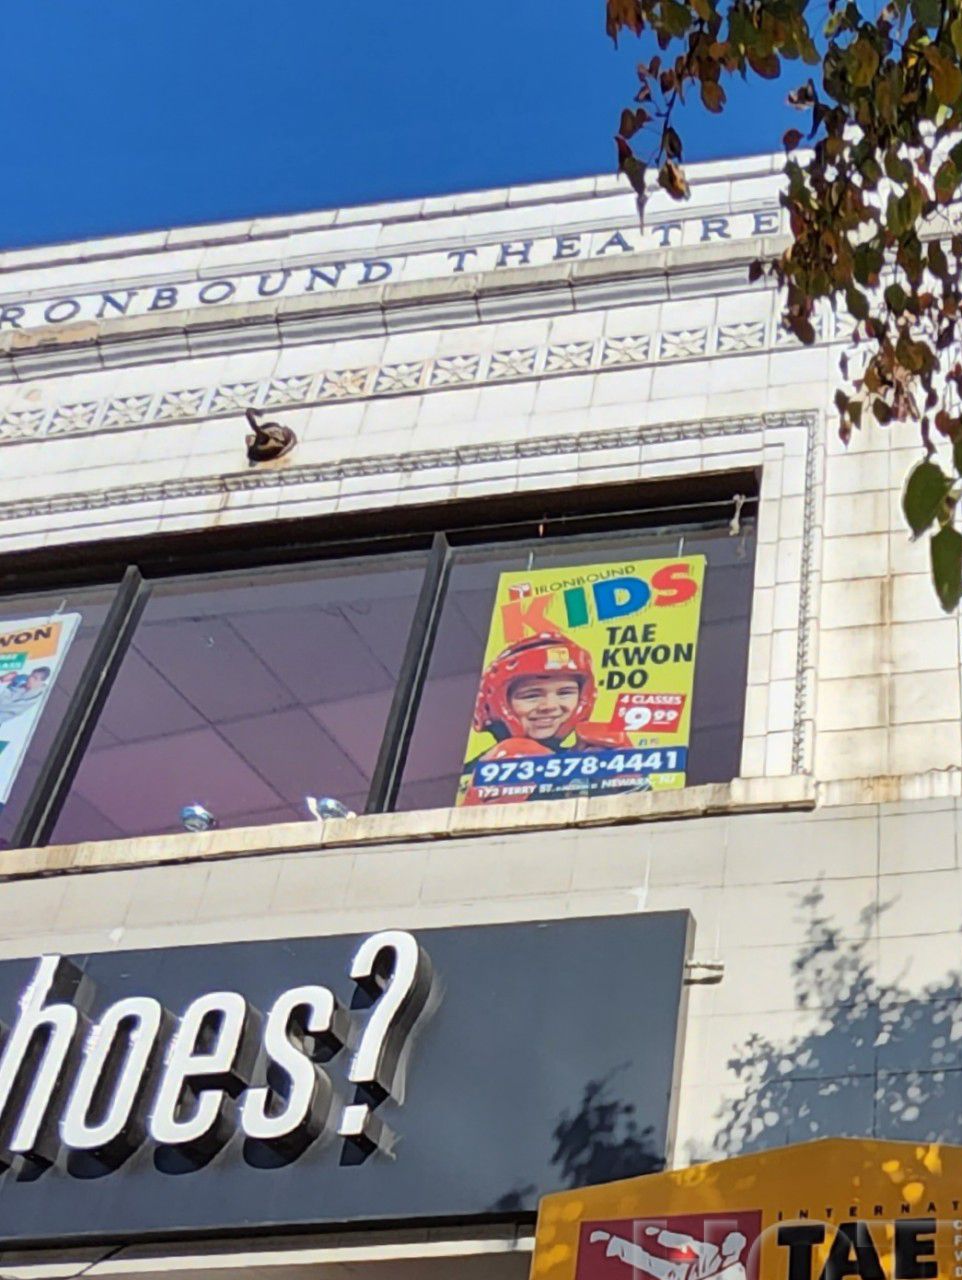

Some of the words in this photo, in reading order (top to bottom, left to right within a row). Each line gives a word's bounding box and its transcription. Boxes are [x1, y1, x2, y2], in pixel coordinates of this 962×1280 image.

[448, 211, 779, 272] THEATRE
[535, 565, 635, 595] IRONBOUND
[500, 563, 697, 643] KIDS
[606, 624, 656, 645] TAE
[602, 643, 693, 668] KWON
[620, 694, 630, 704] 4
